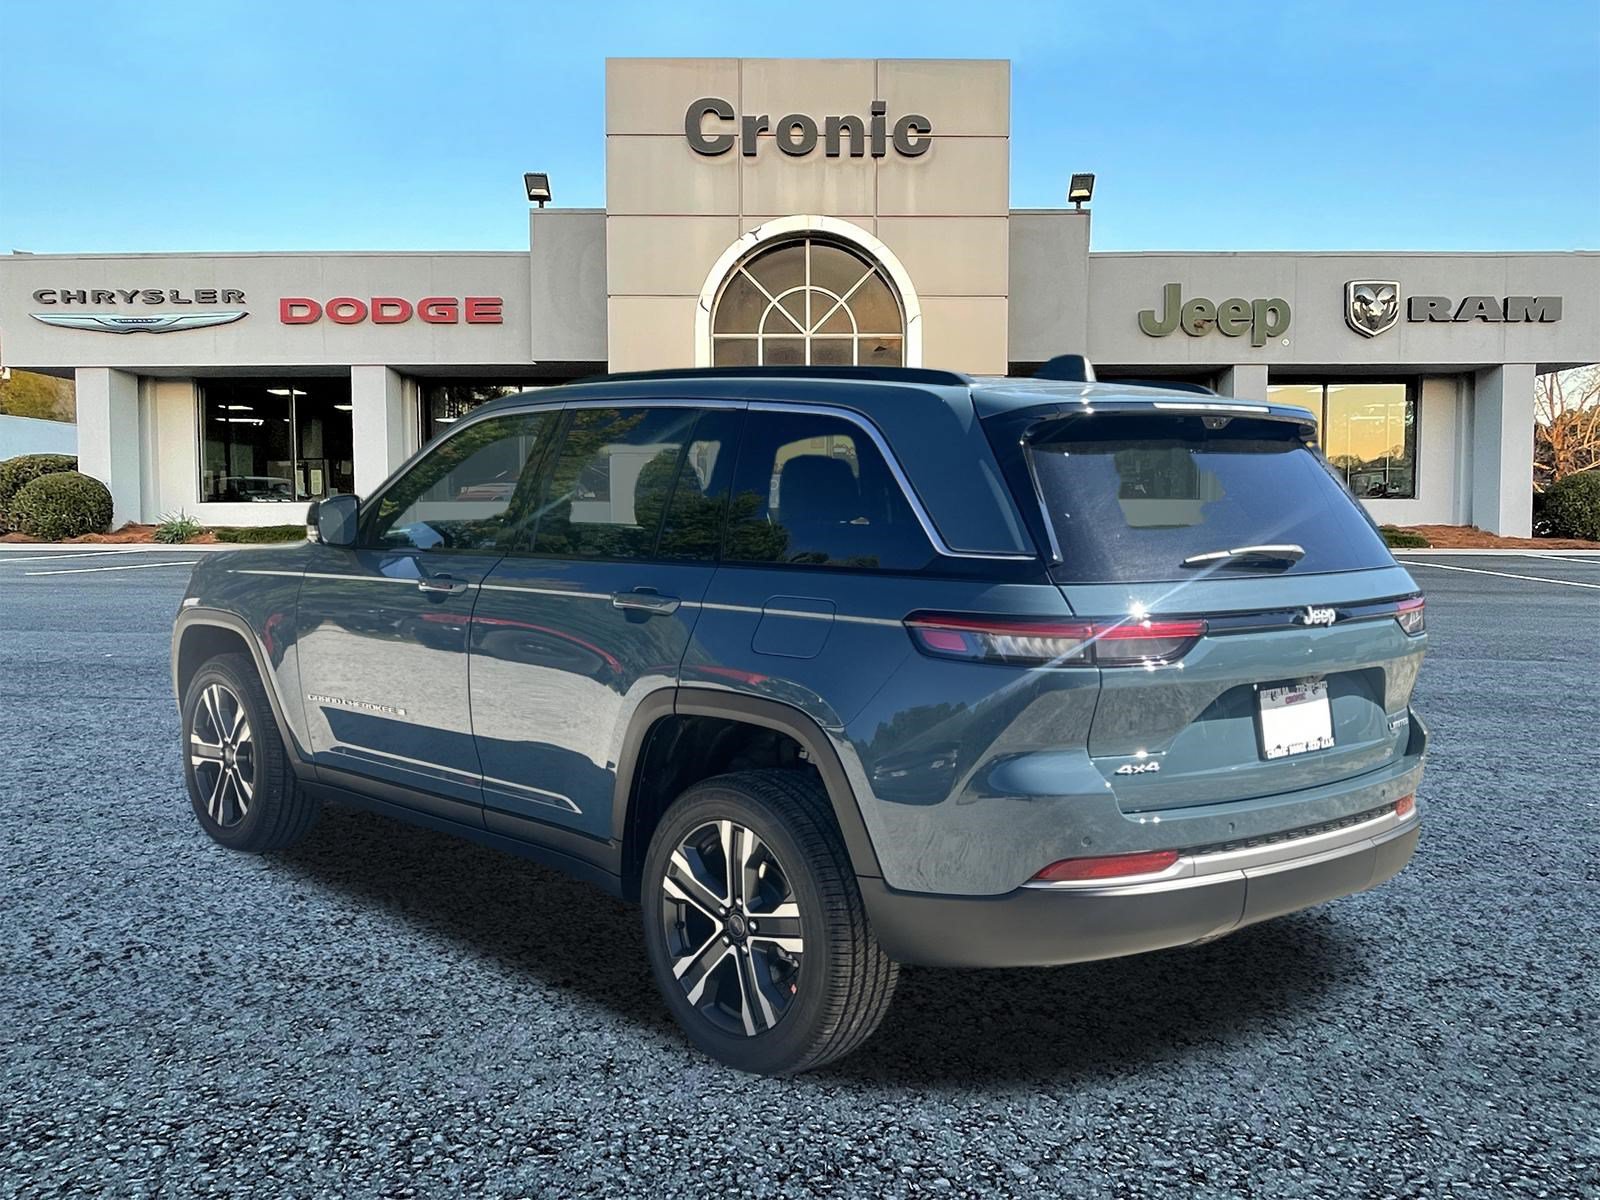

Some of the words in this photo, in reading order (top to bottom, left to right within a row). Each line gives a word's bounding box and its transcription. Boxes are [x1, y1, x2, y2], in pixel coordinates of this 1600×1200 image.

[684, 97, 932, 157] Cronic
[32, 289, 246, 304] CHRYSLER
[1407, 296, 1563, 322] RAM
[280, 297, 503, 324] DODGE
[1138, 283, 1291, 347] Jeep
[1303, 605, 1336, 627] Jeep
[1115, 761, 1160, 775] 4x4
